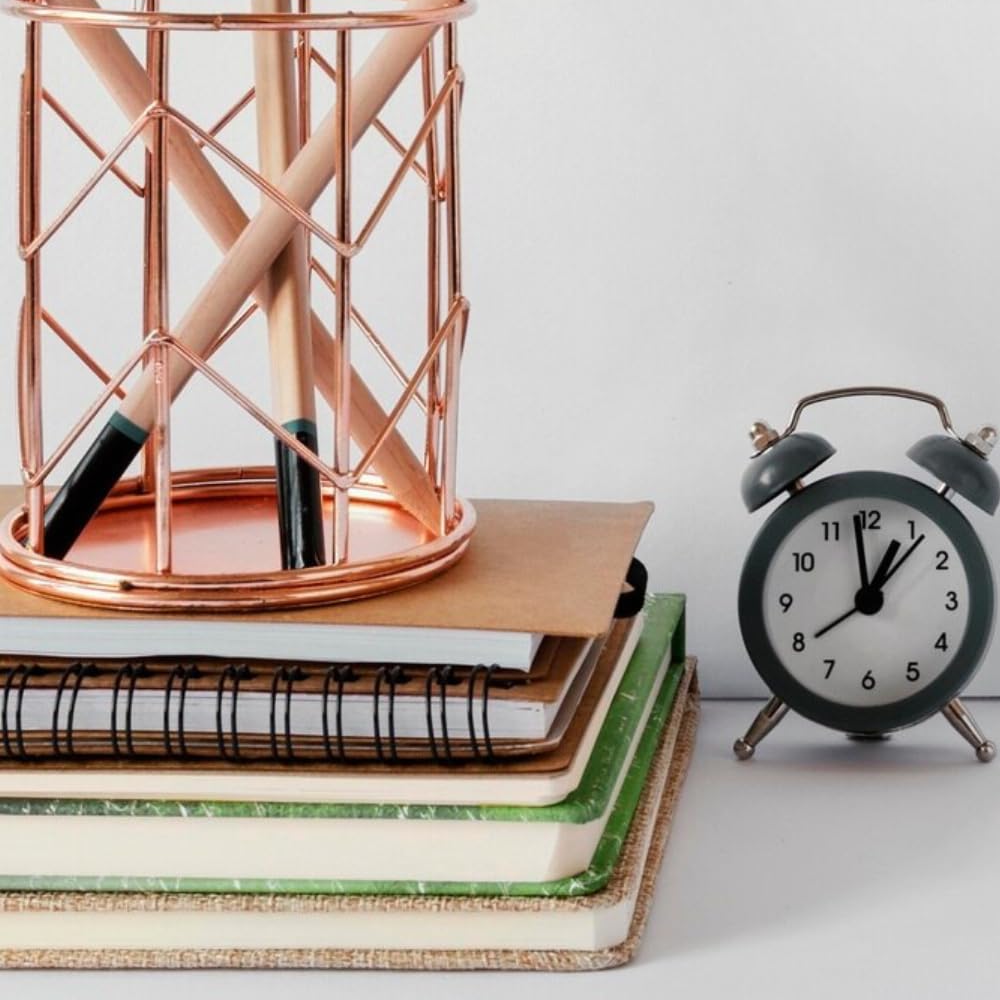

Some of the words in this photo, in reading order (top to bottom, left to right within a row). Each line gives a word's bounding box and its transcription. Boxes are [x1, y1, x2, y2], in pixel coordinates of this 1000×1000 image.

[858, 509, 882, 531] 12
[907, 519, 916, 541] 1
[821, 521, 840, 542] 11
[792, 551, 816, 573] 10
[935, 550, 950, 571] 2
[778, 593, 794, 613] 9
[945, 591, 959, 611] 3
[792, 631, 806, 653] 8
[934, 632, 949, 652] 4
[823, 659, 836, 680] 7
[861, 669, 876, 691] 6
[905, 661, 921, 683] 5
